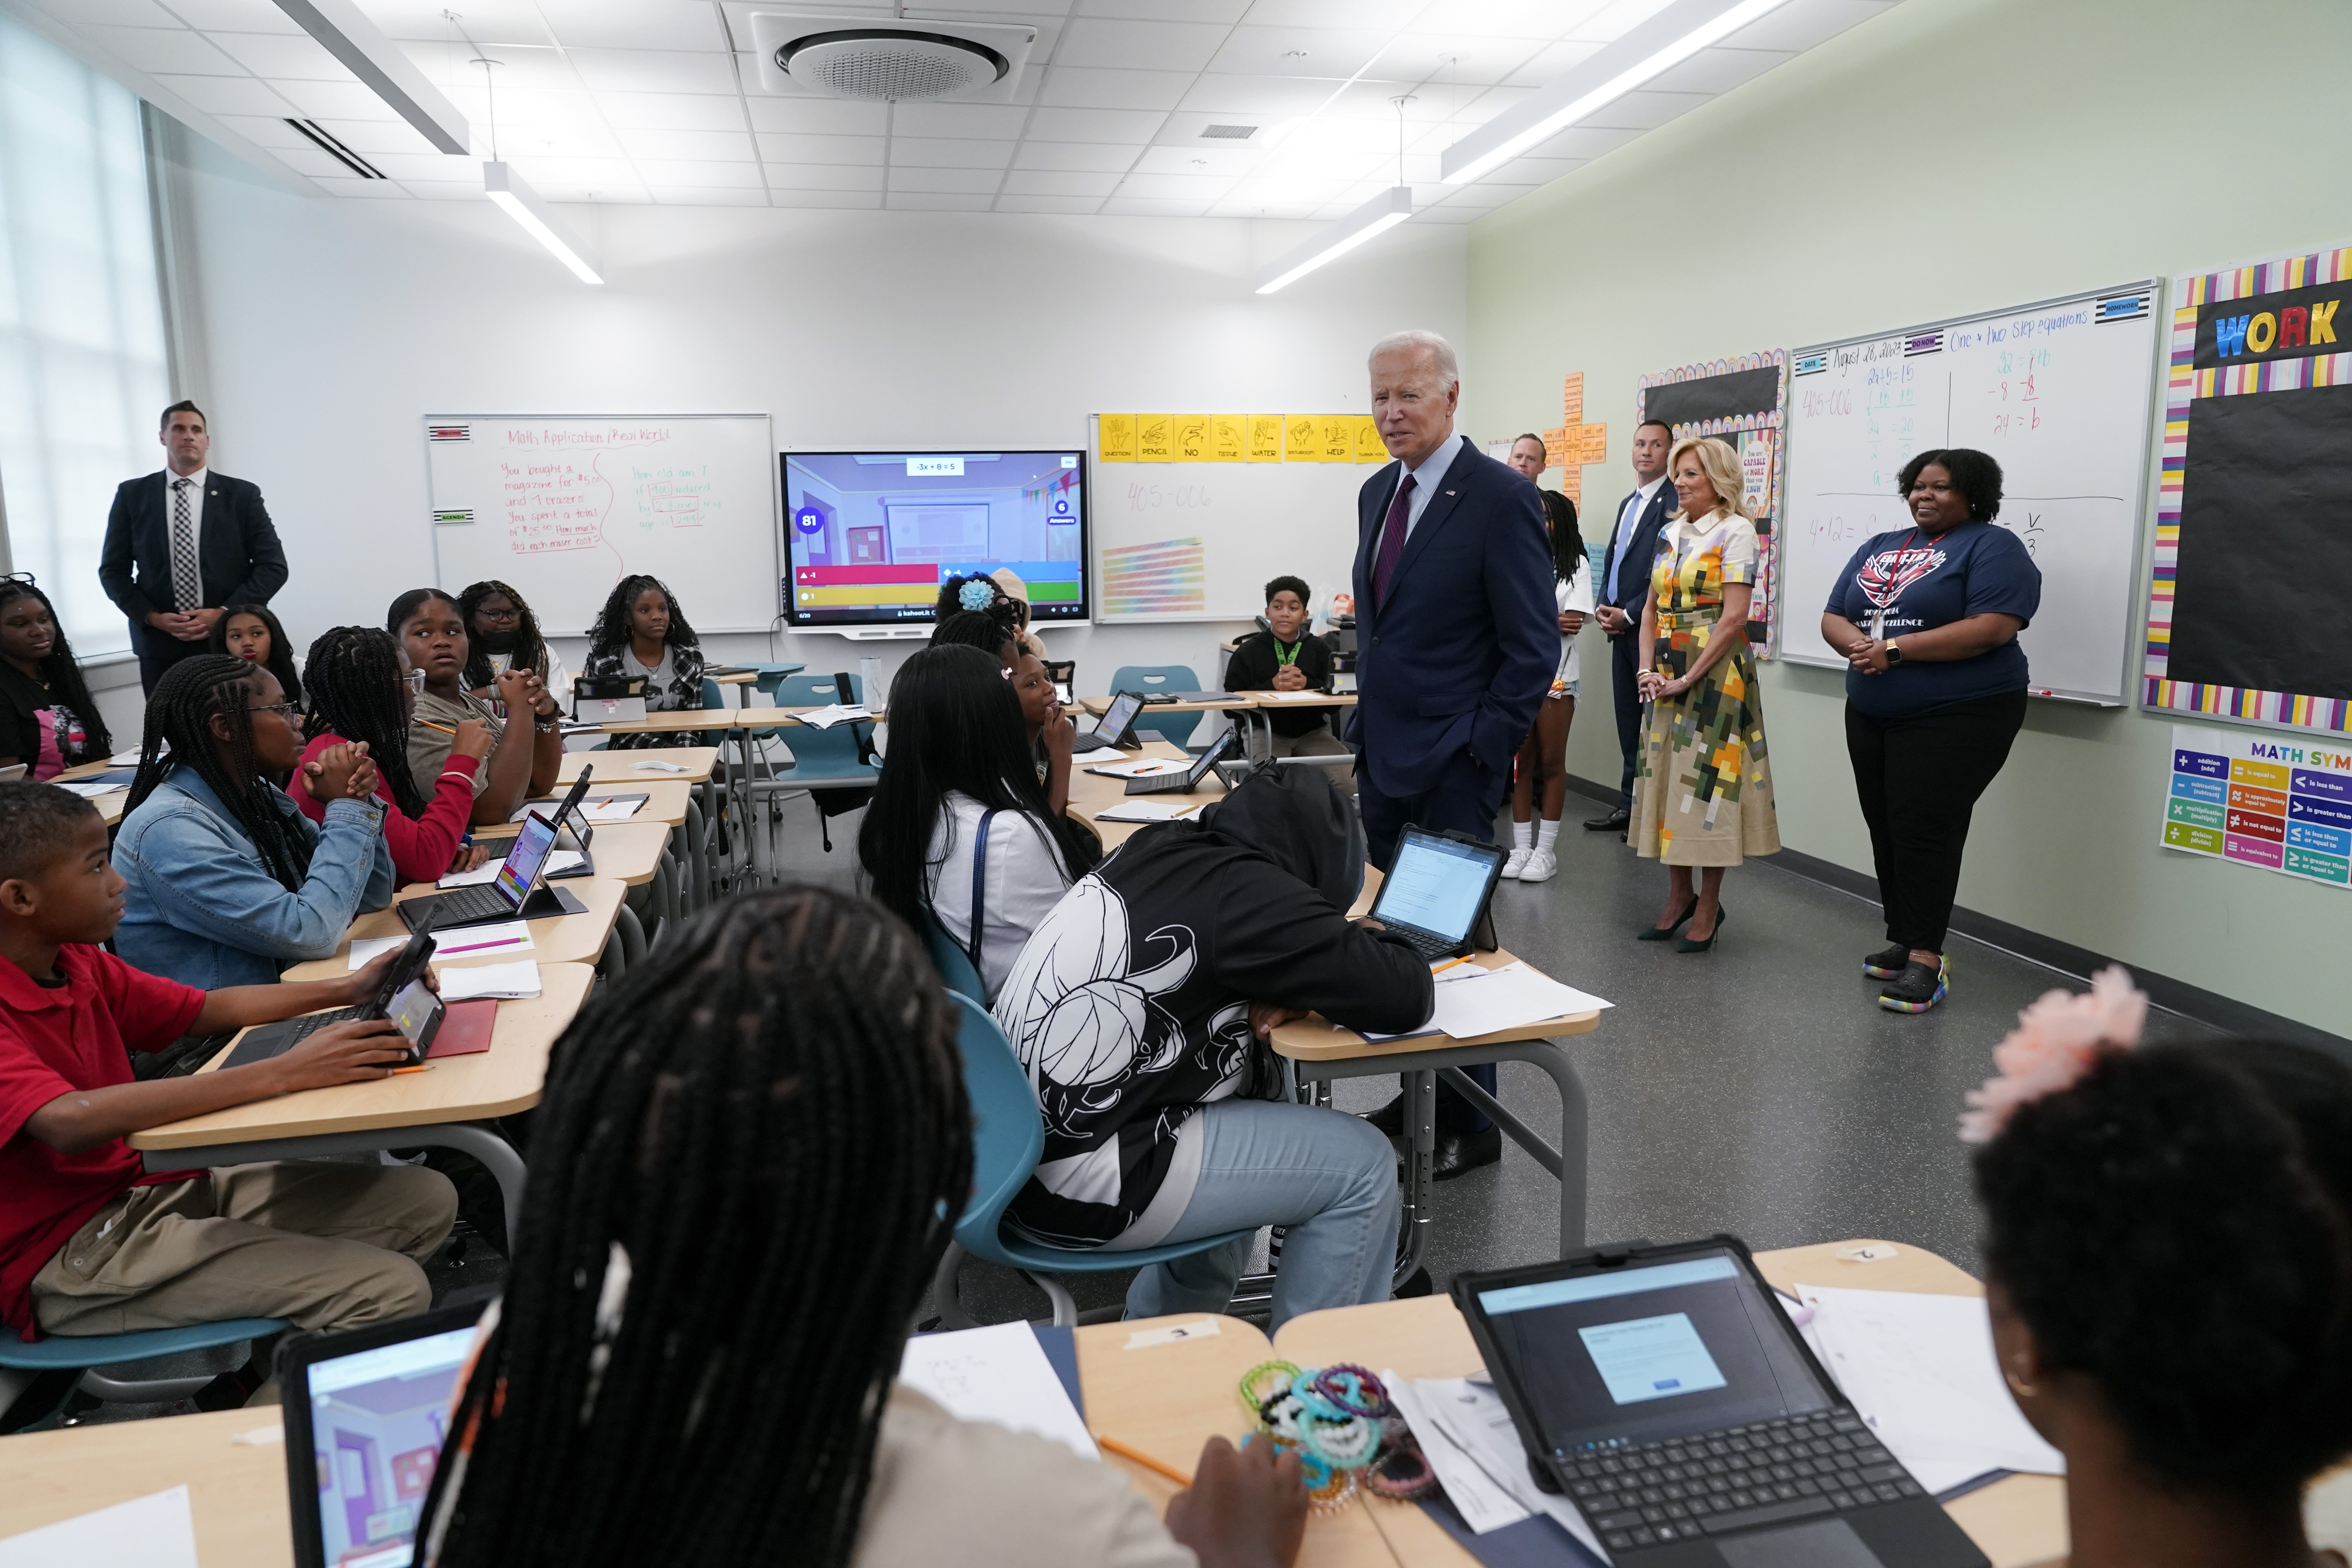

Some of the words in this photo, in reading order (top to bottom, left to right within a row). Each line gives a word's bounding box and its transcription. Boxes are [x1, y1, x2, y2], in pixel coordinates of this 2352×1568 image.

[2107, 302, 2139, 312] HOMEWORK
[1951, 331, 1971, 352] One
[1987, 326, 2007, 345] two
[2038, 311, 2088, 336] equations
[2216, 300, 2340, 358] WORK
[1834, 348, 1859, 377] August
[1879, 342, 1901, 358] 2023
[1998, 351, 2012, 374] 32
[1803, 388, 1851, 417] 405-006
[1994, 414, 2009, 438] 24
[509, 430, 539, 445] Math
[544, 430, 604, 446] Application
[641, 429, 671, 440] World
[1744, 458, 1766, 466] CAPABLE
[502, 463, 519, 478] You
[528, 464, 561, 477] bought
[505, 482, 552, 493] magazine
[559, 475, 574, 489] for
[505, 496, 526, 506] and
[546, 495, 583, 505] erasers
[1129, 483, 1211, 511] 405-006
[1058, 503, 1065, 511] 6
[508, 511, 525, 524] You
[531, 510, 558, 523] spent
[576, 508, 598, 517] total
[802, 515, 816, 526] 81
[510, 526, 519, 536] of
[556, 525, 572, 534] How
[512, 541, 524, 550] did
[530, 541, 547, 550] each
[550, 539, 571, 547] eraser
[2251, 742, 2303, 763] MATH
[2310, 751, 2351, 770] SYM
[2191, 782, 2221, 791] subtraction
[2194, 789, 2220, 799] (subtract)
[2250, 794, 2285, 805] approximately
[2186, 806, 2222, 817] multiplication
[2314, 808, 2336, 817] greater
[2191, 813, 2217, 824] (multiply)
[2191, 831, 2212, 839] division
[2191, 837, 2211, 847] (divide)
[2246, 848, 2272, 858] equivalent
[2310, 858, 2331, 867] greater
